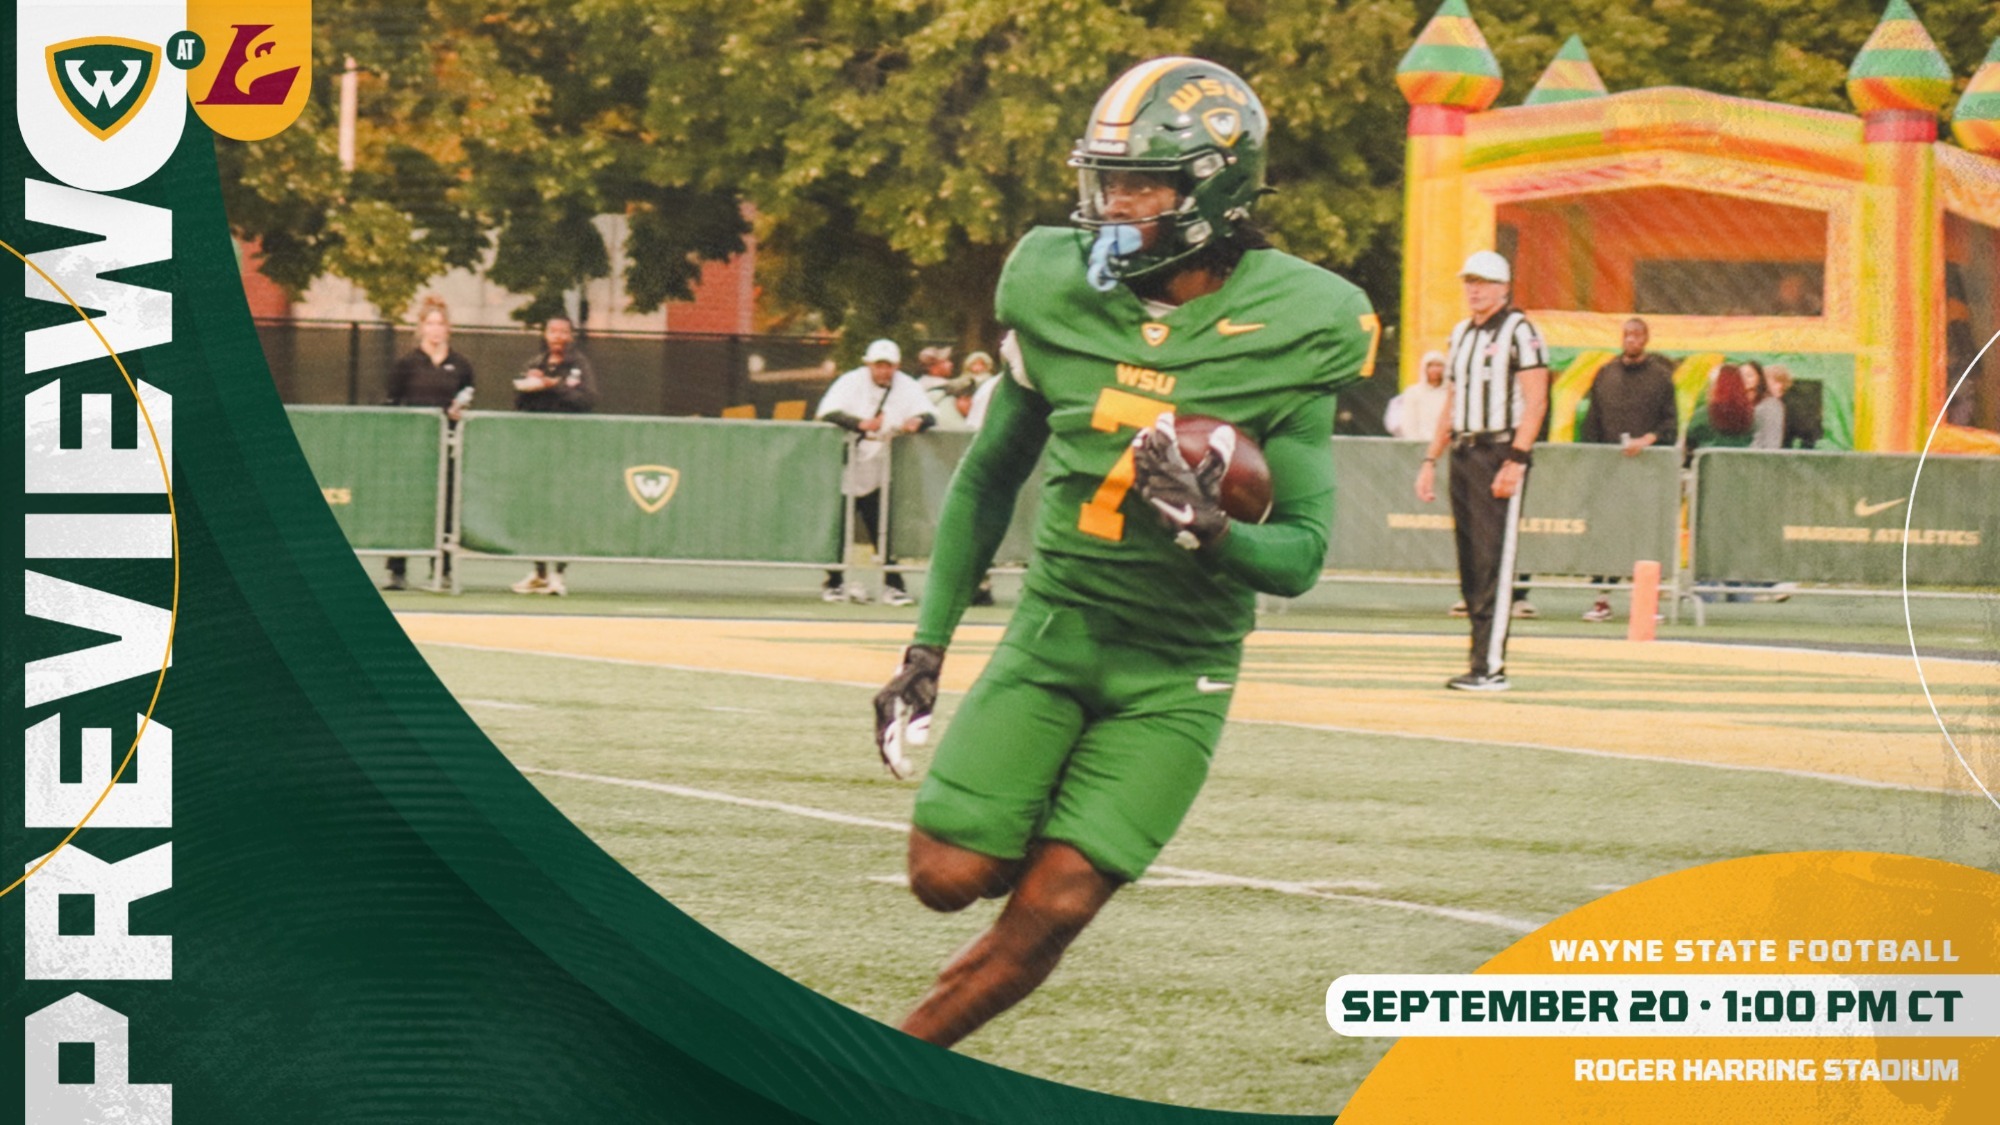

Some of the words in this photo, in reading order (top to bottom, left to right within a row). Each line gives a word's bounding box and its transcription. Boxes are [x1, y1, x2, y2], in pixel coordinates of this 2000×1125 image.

[1167, 79, 1249, 113] WSU
[1116, 363, 1177, 396] WSU
[1078, 386, 1177, 542] 7
[1874, 528, 1981, 546] ATHLETICS
